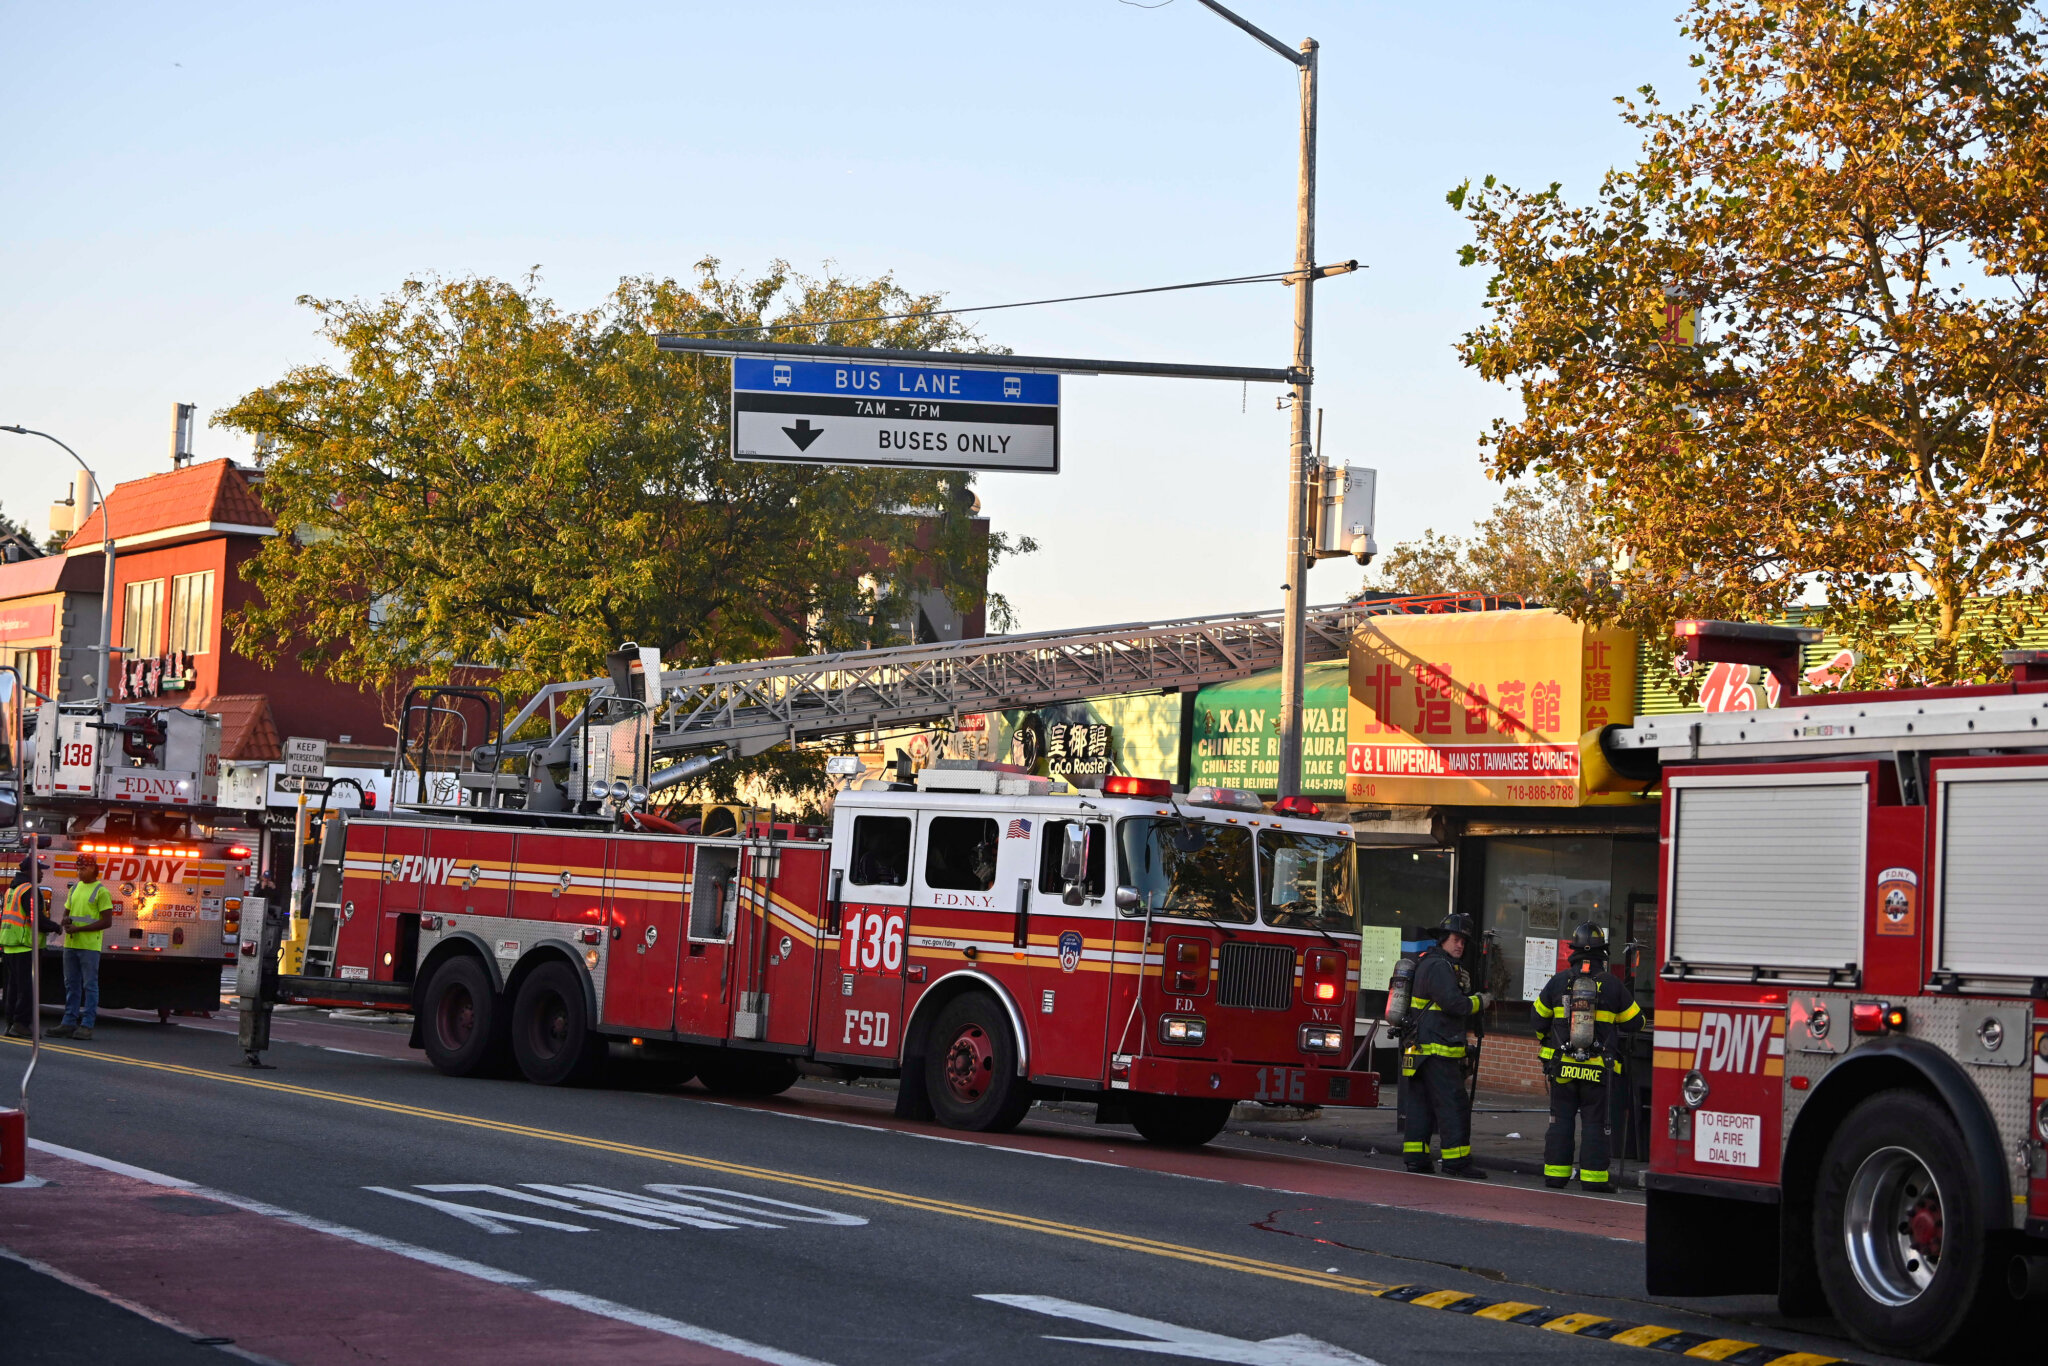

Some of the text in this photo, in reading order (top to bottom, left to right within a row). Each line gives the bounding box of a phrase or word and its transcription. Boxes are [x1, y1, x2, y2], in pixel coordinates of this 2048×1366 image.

[835, 370, 961, 394] BUS LANE
[855, 401, 886, 416] 7AM
[908, 404, 940, 418] 7PM
[879, 430, 1011, 454] BUSES ONLY
[976, 718, 984, 728] FU
[1219, 708, 1265, 733] KAN
[1302, 707, 1347, 733] WAH
[296, 742, 317, 752] KEEP
[1198, 737, 1260, 756] CHINESE
[62, 743, 93, 767] 138
[289, 753, 324, 763] INTERSECTION
[1351, 747, 1360, 772] C
[1363, 748, 1373, 772] &
[1376, 748, 1384, 773] L
[1386, 748, 1445, 774] IMPERIAL
[1449, 752, 1469, 771] MAIN
[1469, 753, 1482, 771] ST.
[1482, 752, 1529, 771] TAIWANESE
[1532, 751, 1574, 771] GOURMET
[204, 753, 218, 776] 138
[292, 764, 318, 774] CLEAR
[1049, 757, 1107, 775] CoCo Rooster
[1202, 760, 1246, 774] CHINESE
[1252, 760, 1279, 774] FOOD
[1305, 760, 1333, 775] TAKE
[124, 777, 182, 796] F.D.N.Y.
[283, 780, 326, 790] ONE WAY
[1222, 777, 1241, 788] FREE
[1243, 777, 1279, 789] DELIVERY
[1352, 783, 1376, 797] 59-10
[1506, 785, 1574, 801] 718-886-8788
[104, 857, 184, 883] FDNY
[400, 854, 456, 885] FDNY
[175, 904, 196, 912] BACK
[934, 893, 995, 908] F.D.N.Y.
[846, 913, 904, 970] 136
[1175, 997, 1195, 1012] F.D.
[1312, 1008, 1332, 1021] N.Y.
[843, 1009, 890, 1047] FSD
[1694, 1011, 1771, 1074] FDNY
[1254, 1067, 1306, 1101] 136
[1701, 1114, 1755, 1130] TO REPORT
[1713, 1132, 1744, 1146] A FIRE
[1709, 1148, 1747, 1164] DIAL 911
